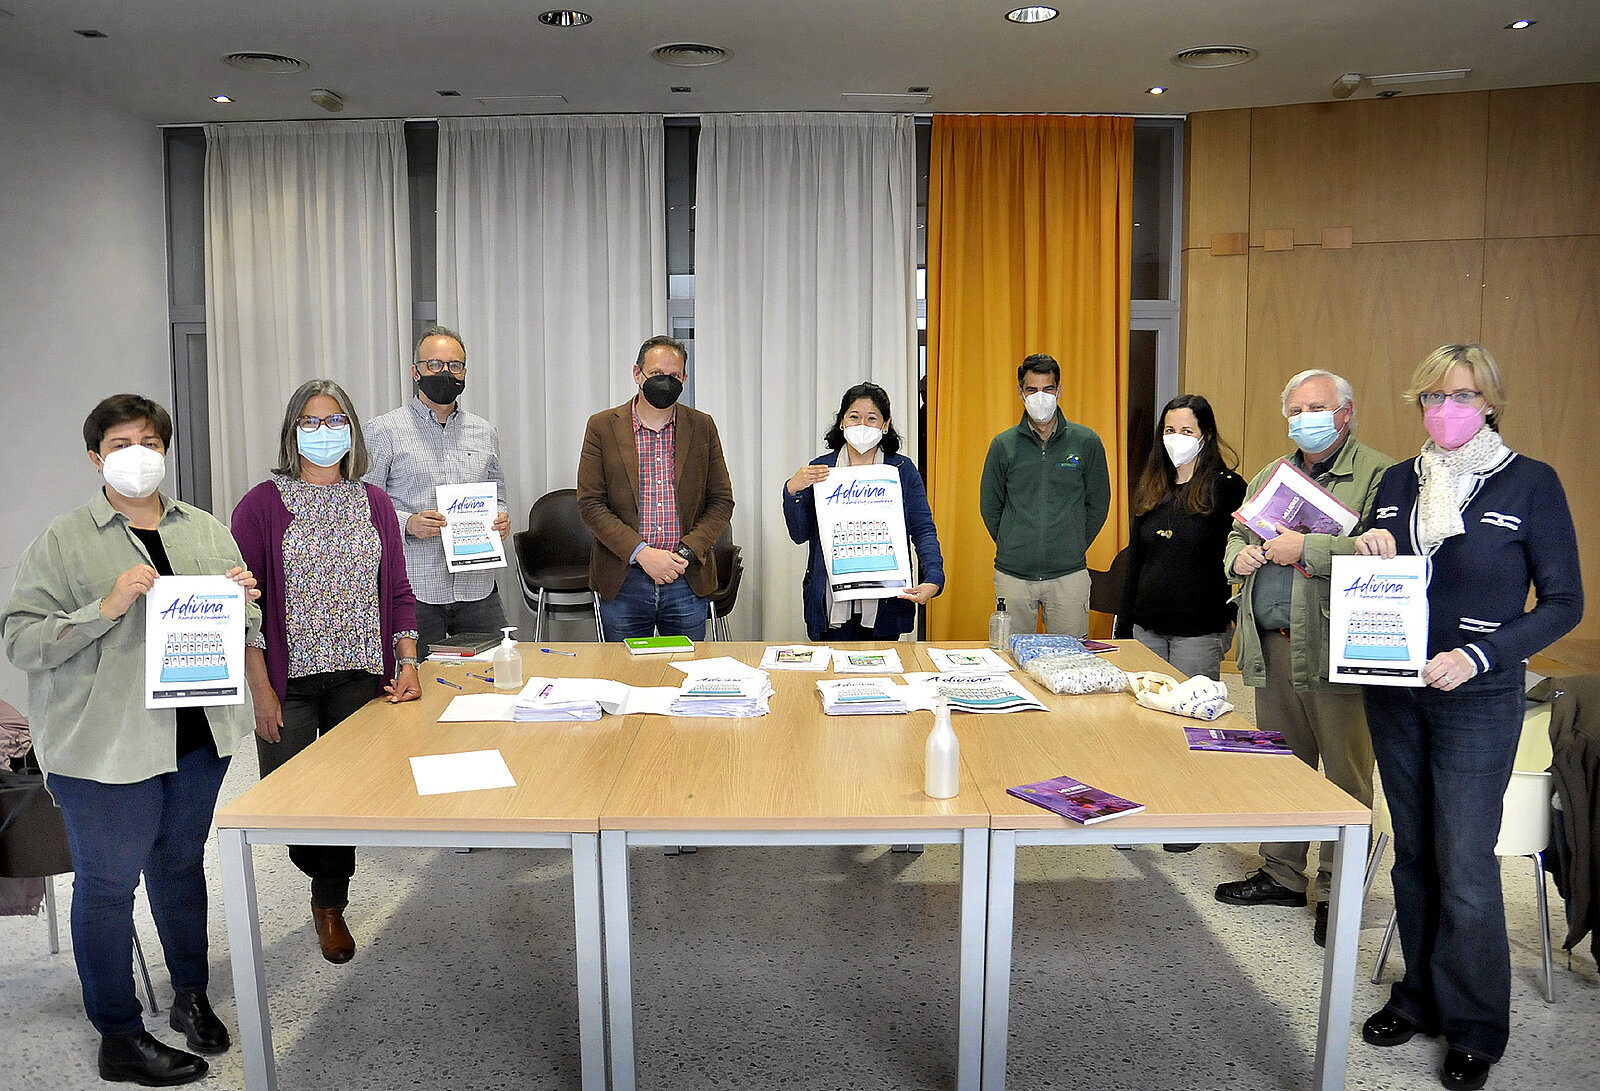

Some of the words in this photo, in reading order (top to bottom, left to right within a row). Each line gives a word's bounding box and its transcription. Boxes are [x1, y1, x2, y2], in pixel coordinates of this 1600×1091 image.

[825, 479, 886, 506] Adivina
[446, 496, 485, 515] Adivina
[1343, 573, 1404, 598] Adivina
[160, 594, 224, 620] Adivina
